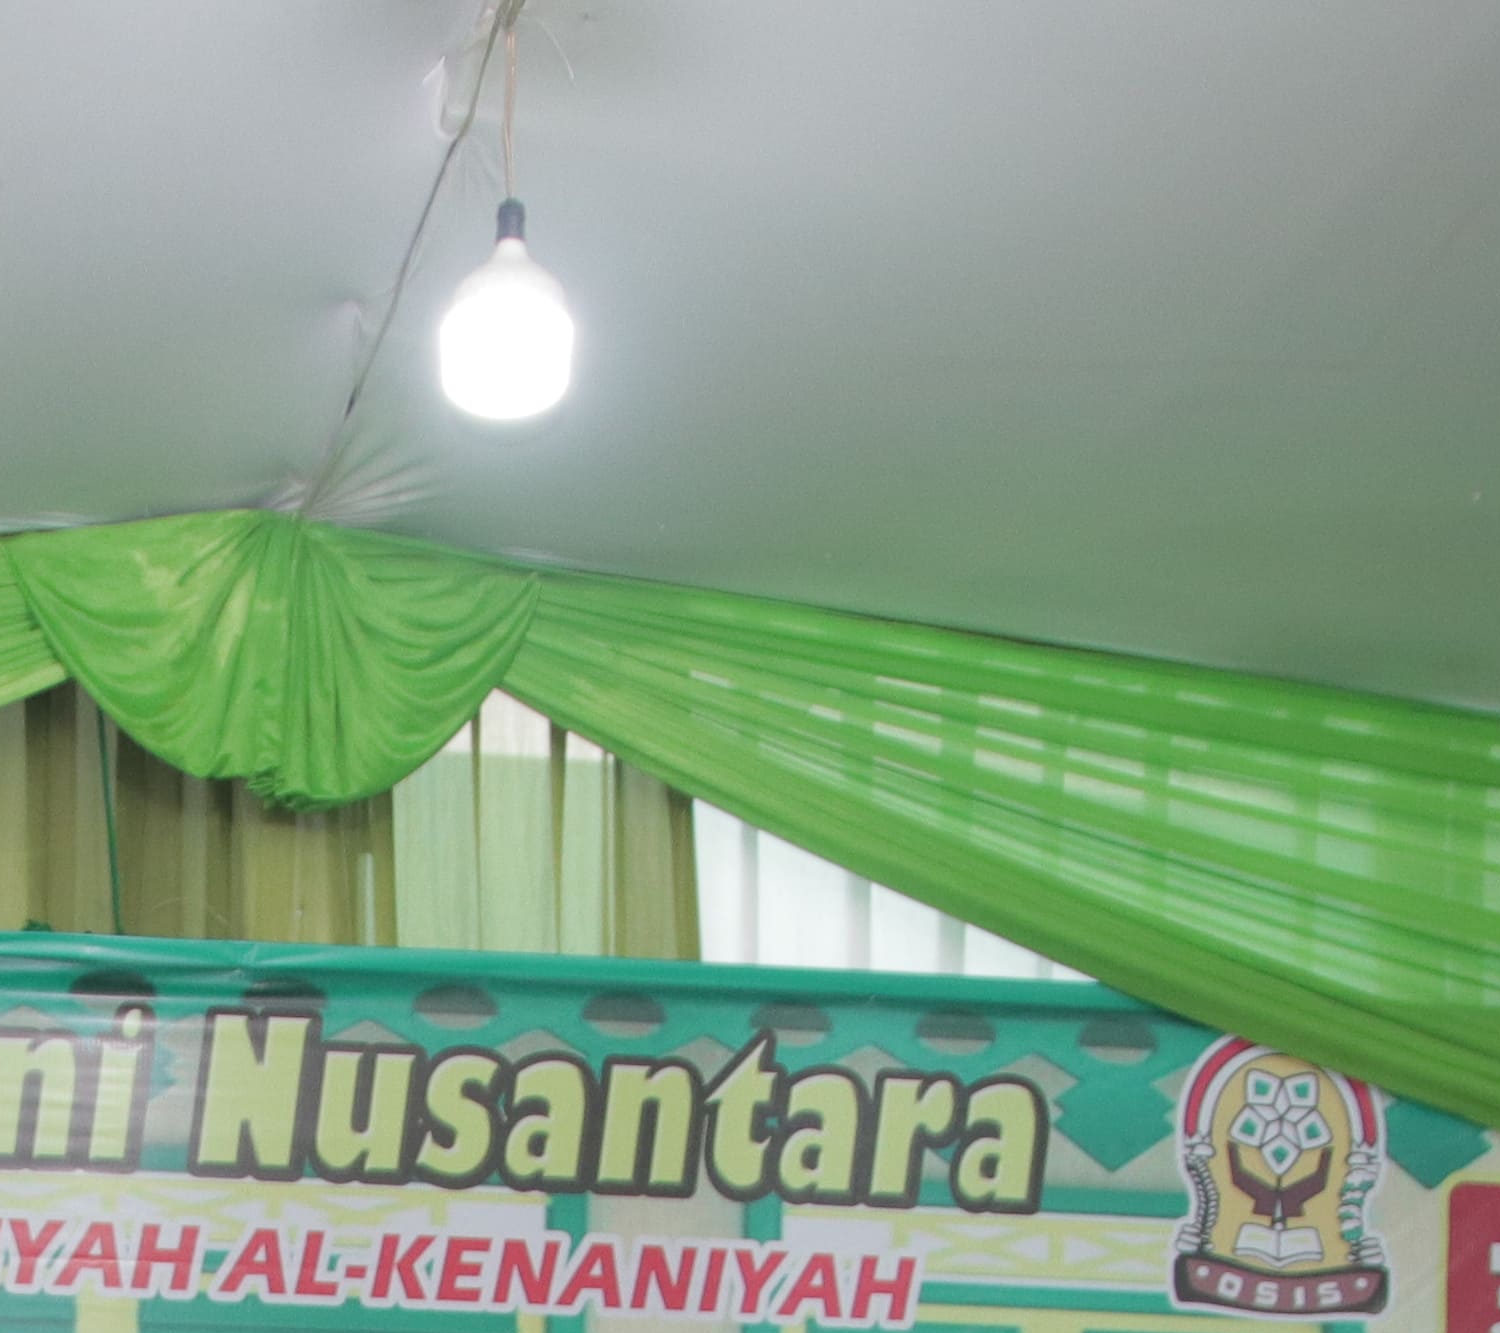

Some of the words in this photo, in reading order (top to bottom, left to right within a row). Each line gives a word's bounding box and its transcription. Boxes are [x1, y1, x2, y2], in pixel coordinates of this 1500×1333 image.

[188, 1006, 1050, 1215] Nusantara
[217, 1227, 917, 1321] AL-KENANIYAH
[1215, 1271, 1344, 1308] OSIS
